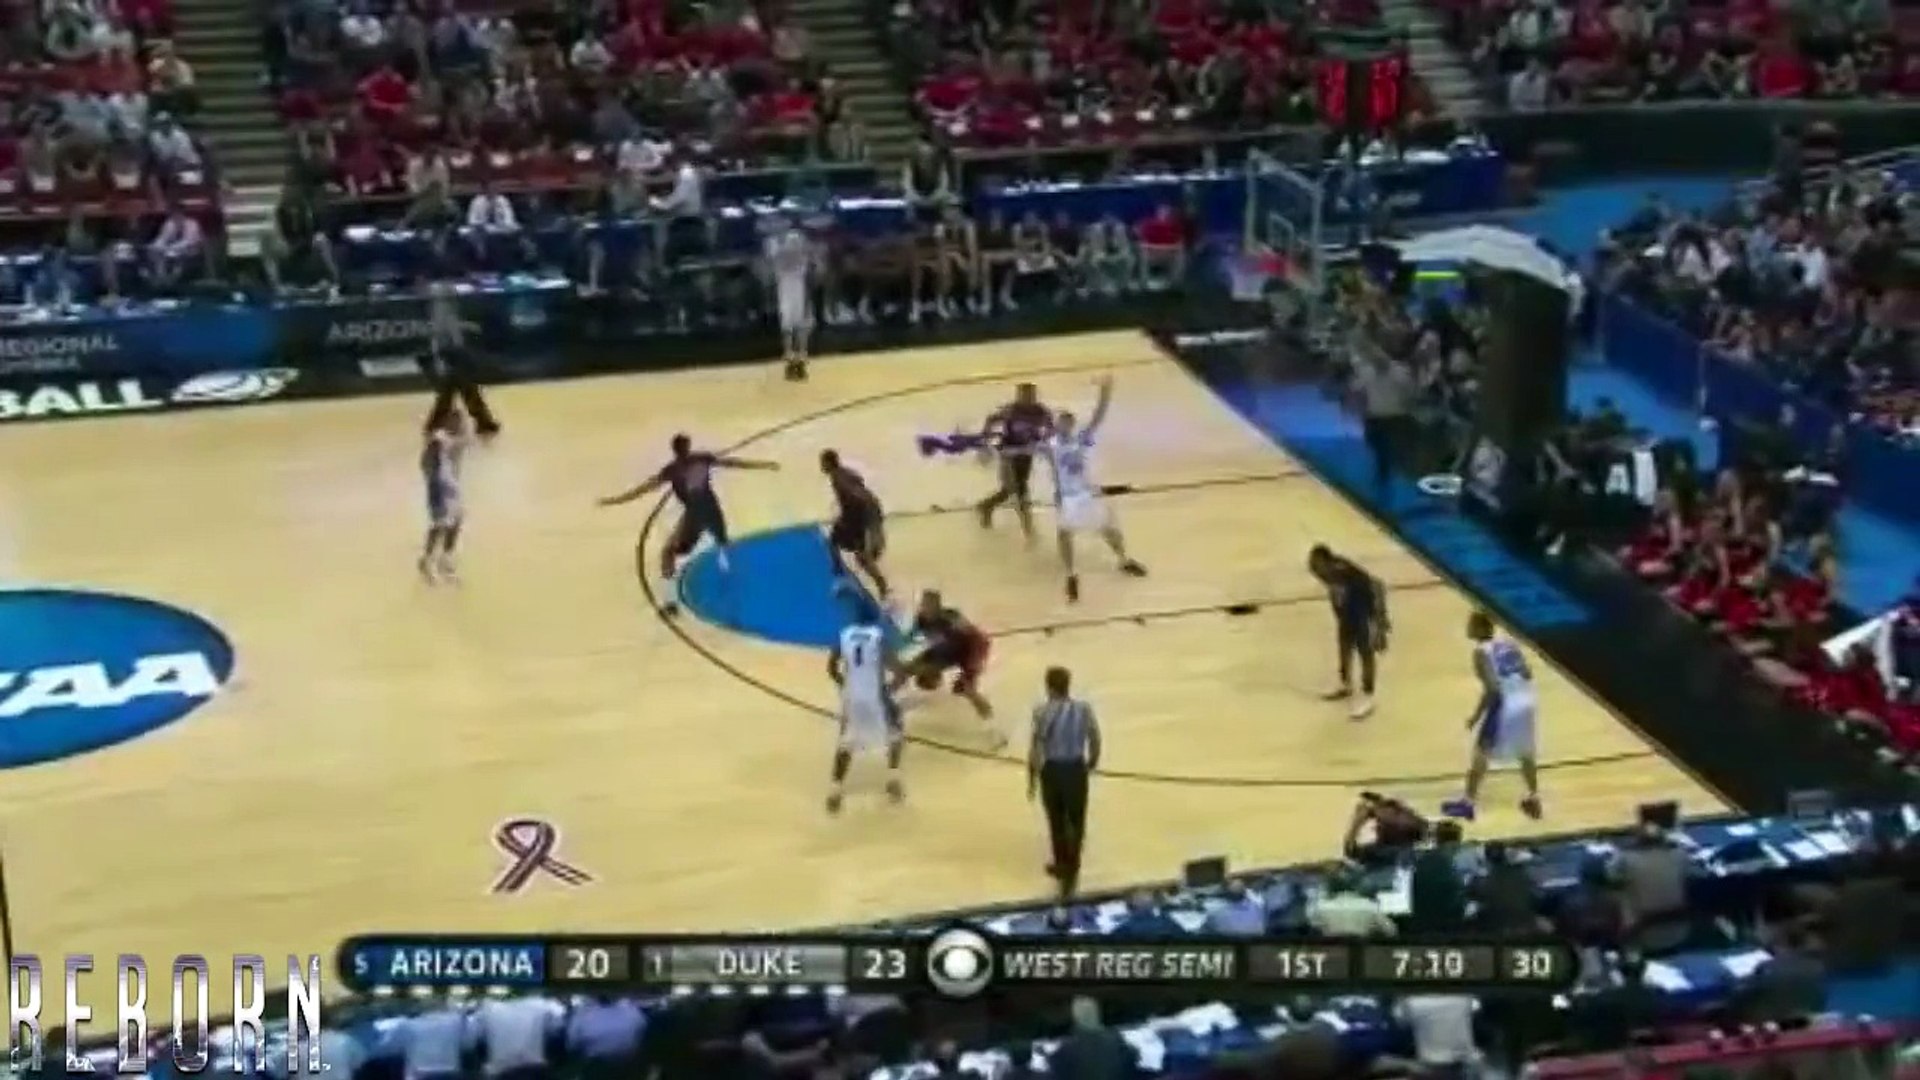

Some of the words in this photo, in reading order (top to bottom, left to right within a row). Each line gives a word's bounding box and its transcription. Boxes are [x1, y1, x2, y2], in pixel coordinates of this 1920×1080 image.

[326, 318, 448, 343] ARIZON
[0, 334, 119, 357] EGIONAL
[0, 652, 218, 717] AA
